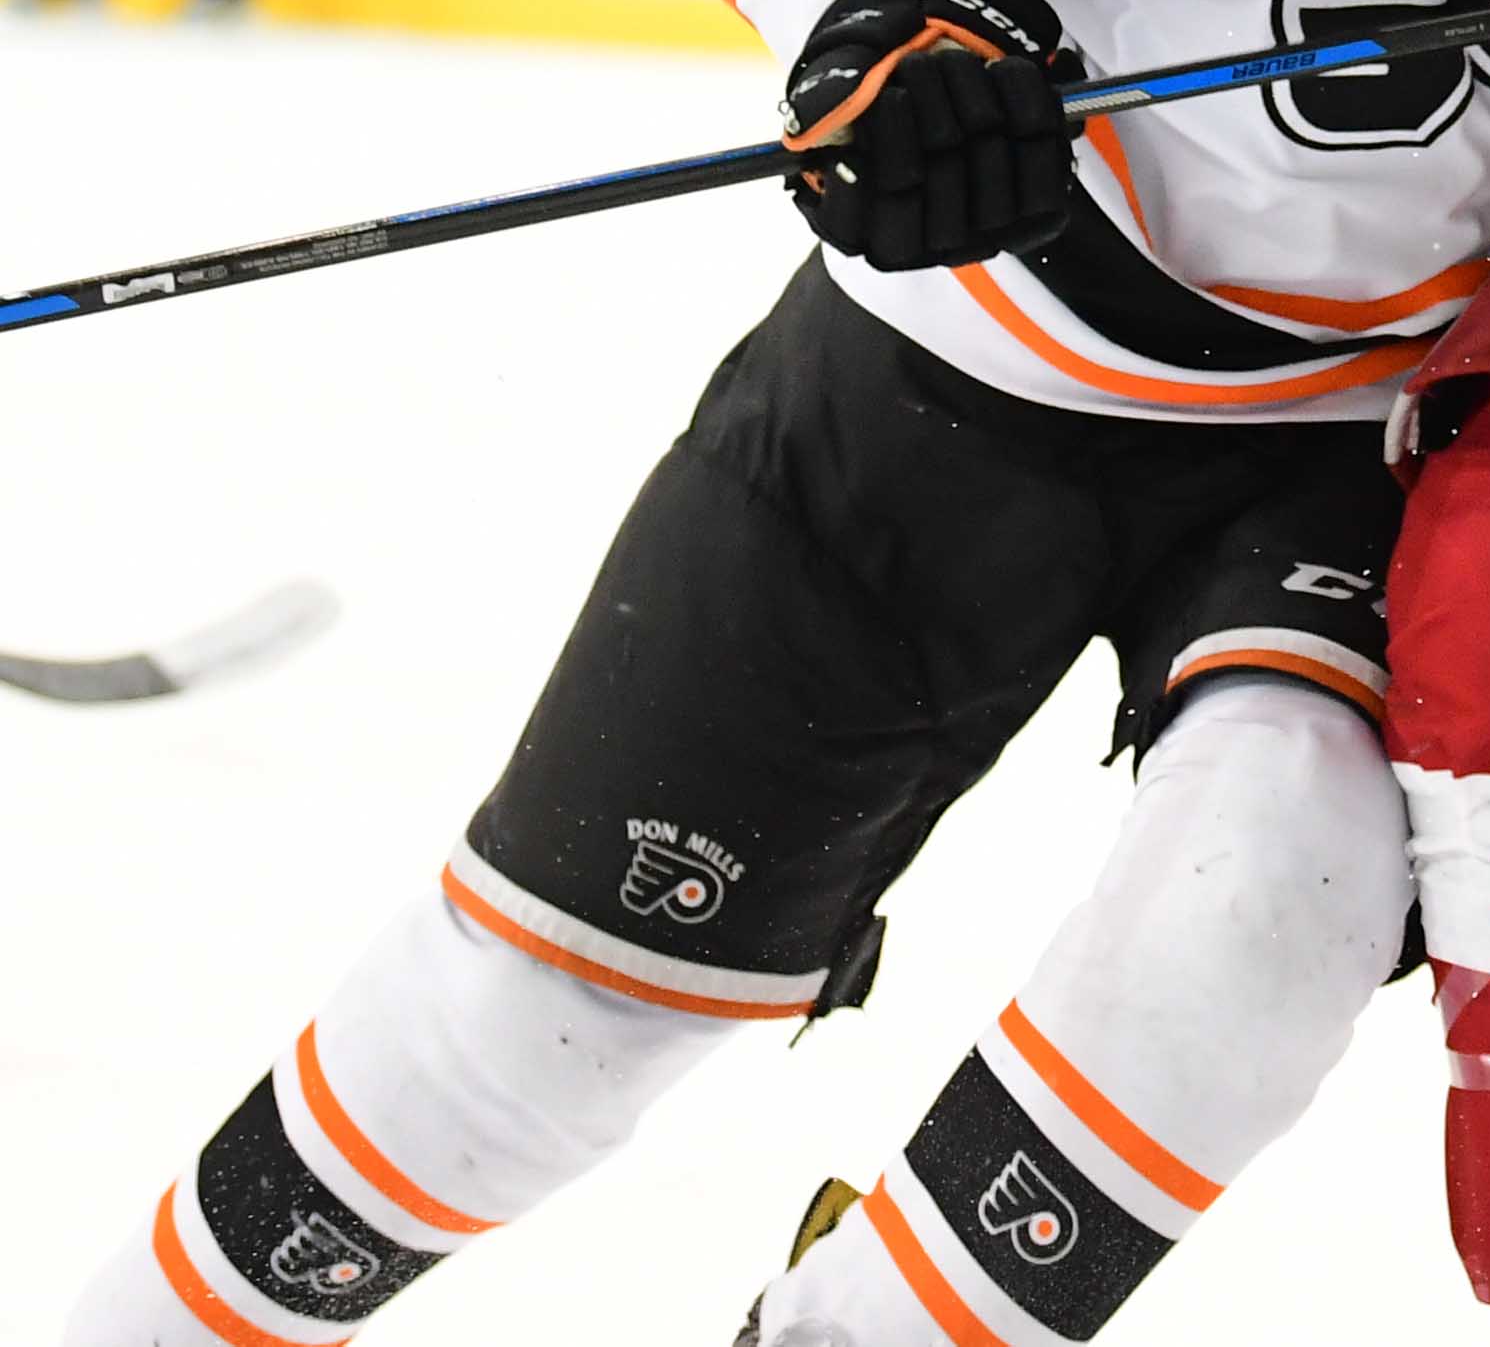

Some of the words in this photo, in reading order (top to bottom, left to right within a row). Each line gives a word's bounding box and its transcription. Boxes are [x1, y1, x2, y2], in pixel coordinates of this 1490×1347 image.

[1231, 52, 1318, 81] BAUER
[626, 818, 679, 844] DON
[685, 832, 746, 882] MILLS
